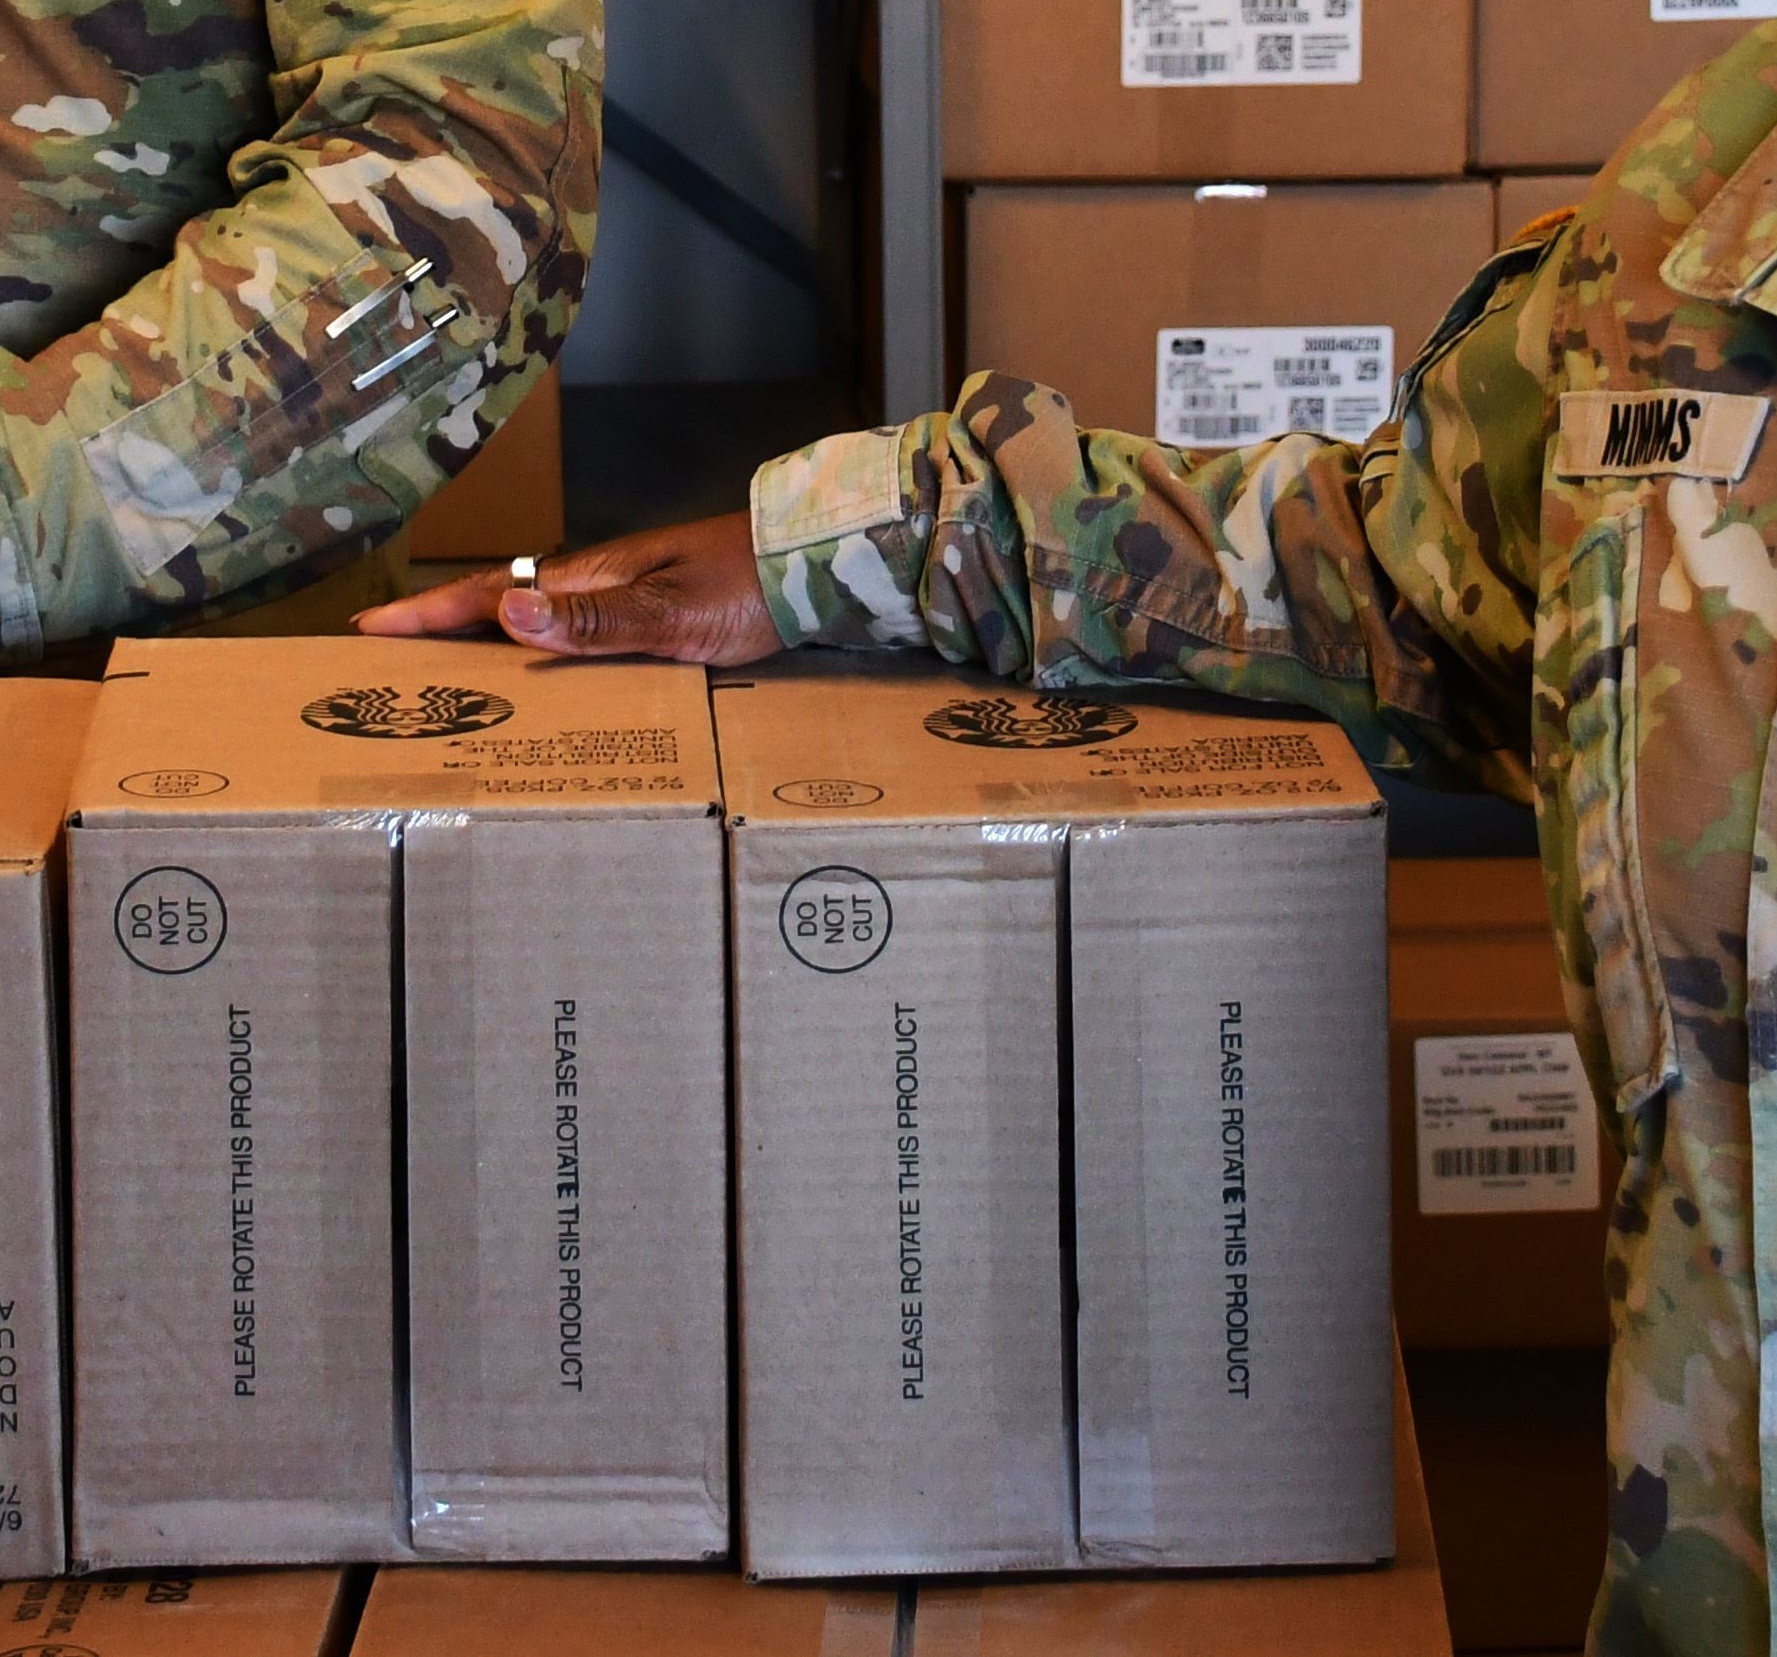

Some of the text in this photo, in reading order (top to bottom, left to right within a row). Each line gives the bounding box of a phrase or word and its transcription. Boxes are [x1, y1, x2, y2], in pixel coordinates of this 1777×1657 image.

[1600, 398, 1701, 468] MIMMS
[131, 903, 152, 940] DO
[158, 895, 180, 946] NOT
[187, 895, 209, 945] CUT
[796, 901, 819, 938] DO
[823, 893, 846, 945] NOT
[852, 894, 875, 943] CUT
[228, 1004, 256, 1397] PLEASE ROTATE THIS PRODUCT
[554, 998, 583, 1392] PLEASE ROTATE THIS PRODUCT
[894, 1001, 924, 1400] PLEASE ROTATE THIS PRODUCT
[1219, 1000, 1250, 1400] PLEASE ROTATE THIS PRODUCT
